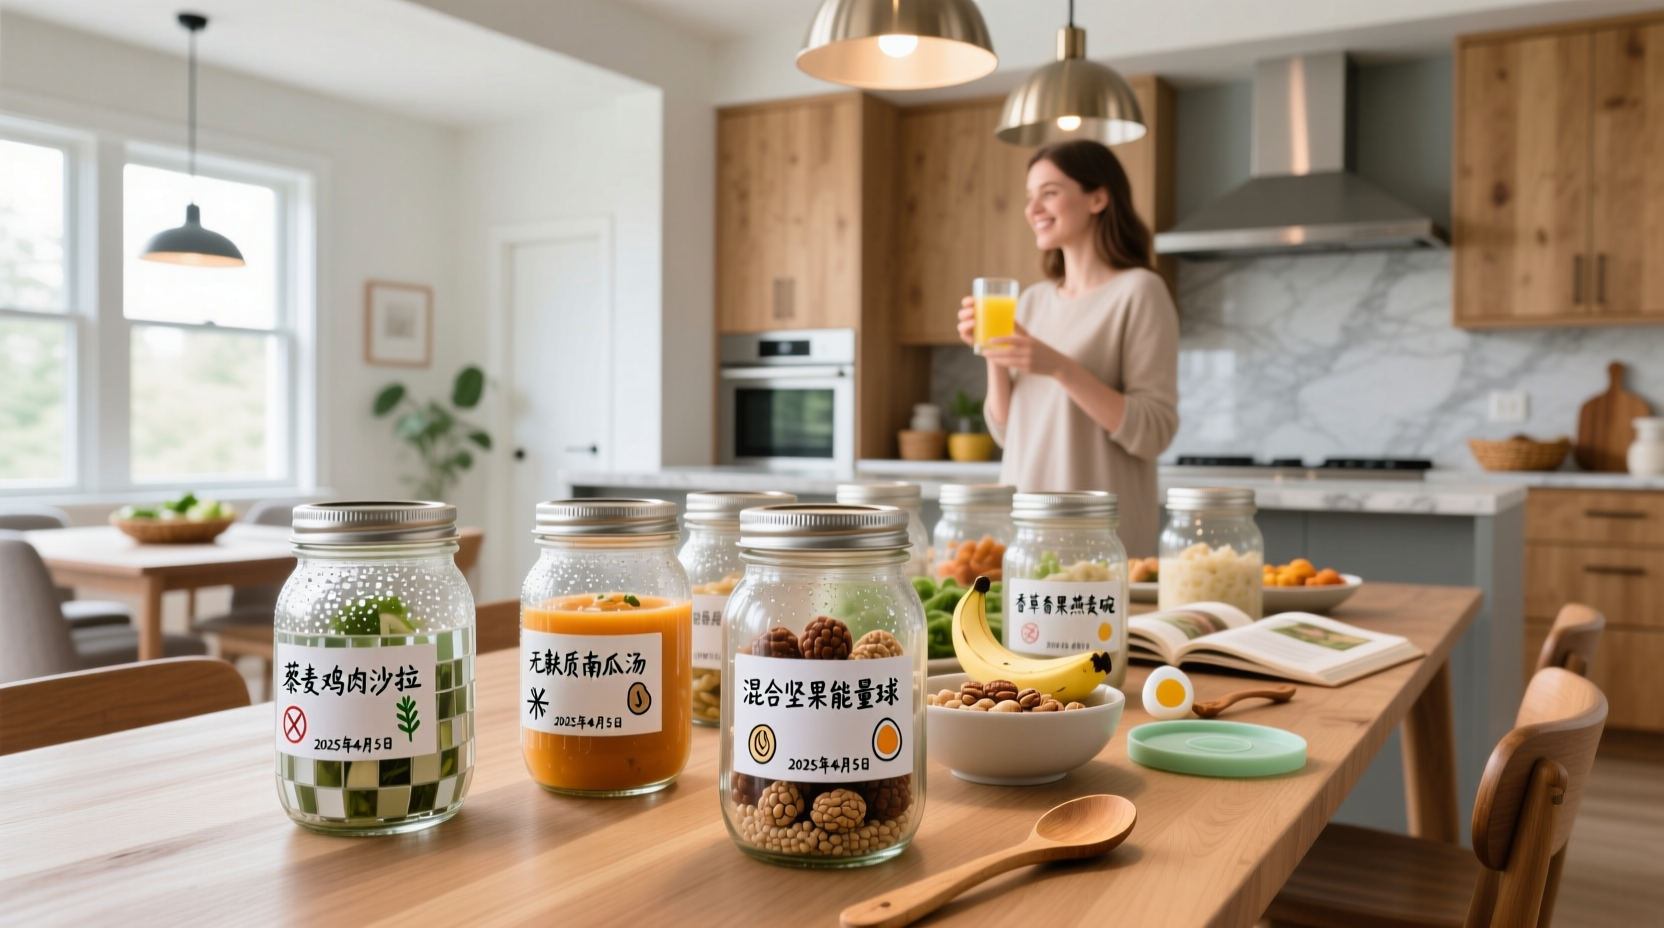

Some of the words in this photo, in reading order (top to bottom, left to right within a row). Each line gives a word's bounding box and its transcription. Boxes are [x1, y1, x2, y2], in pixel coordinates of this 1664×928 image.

[743, 677, 899, 710] 混合坚果能量球
[314, 735, 393, 754] 2025年4月5日
[788, 756, 870, 774] 2025年4月5日
